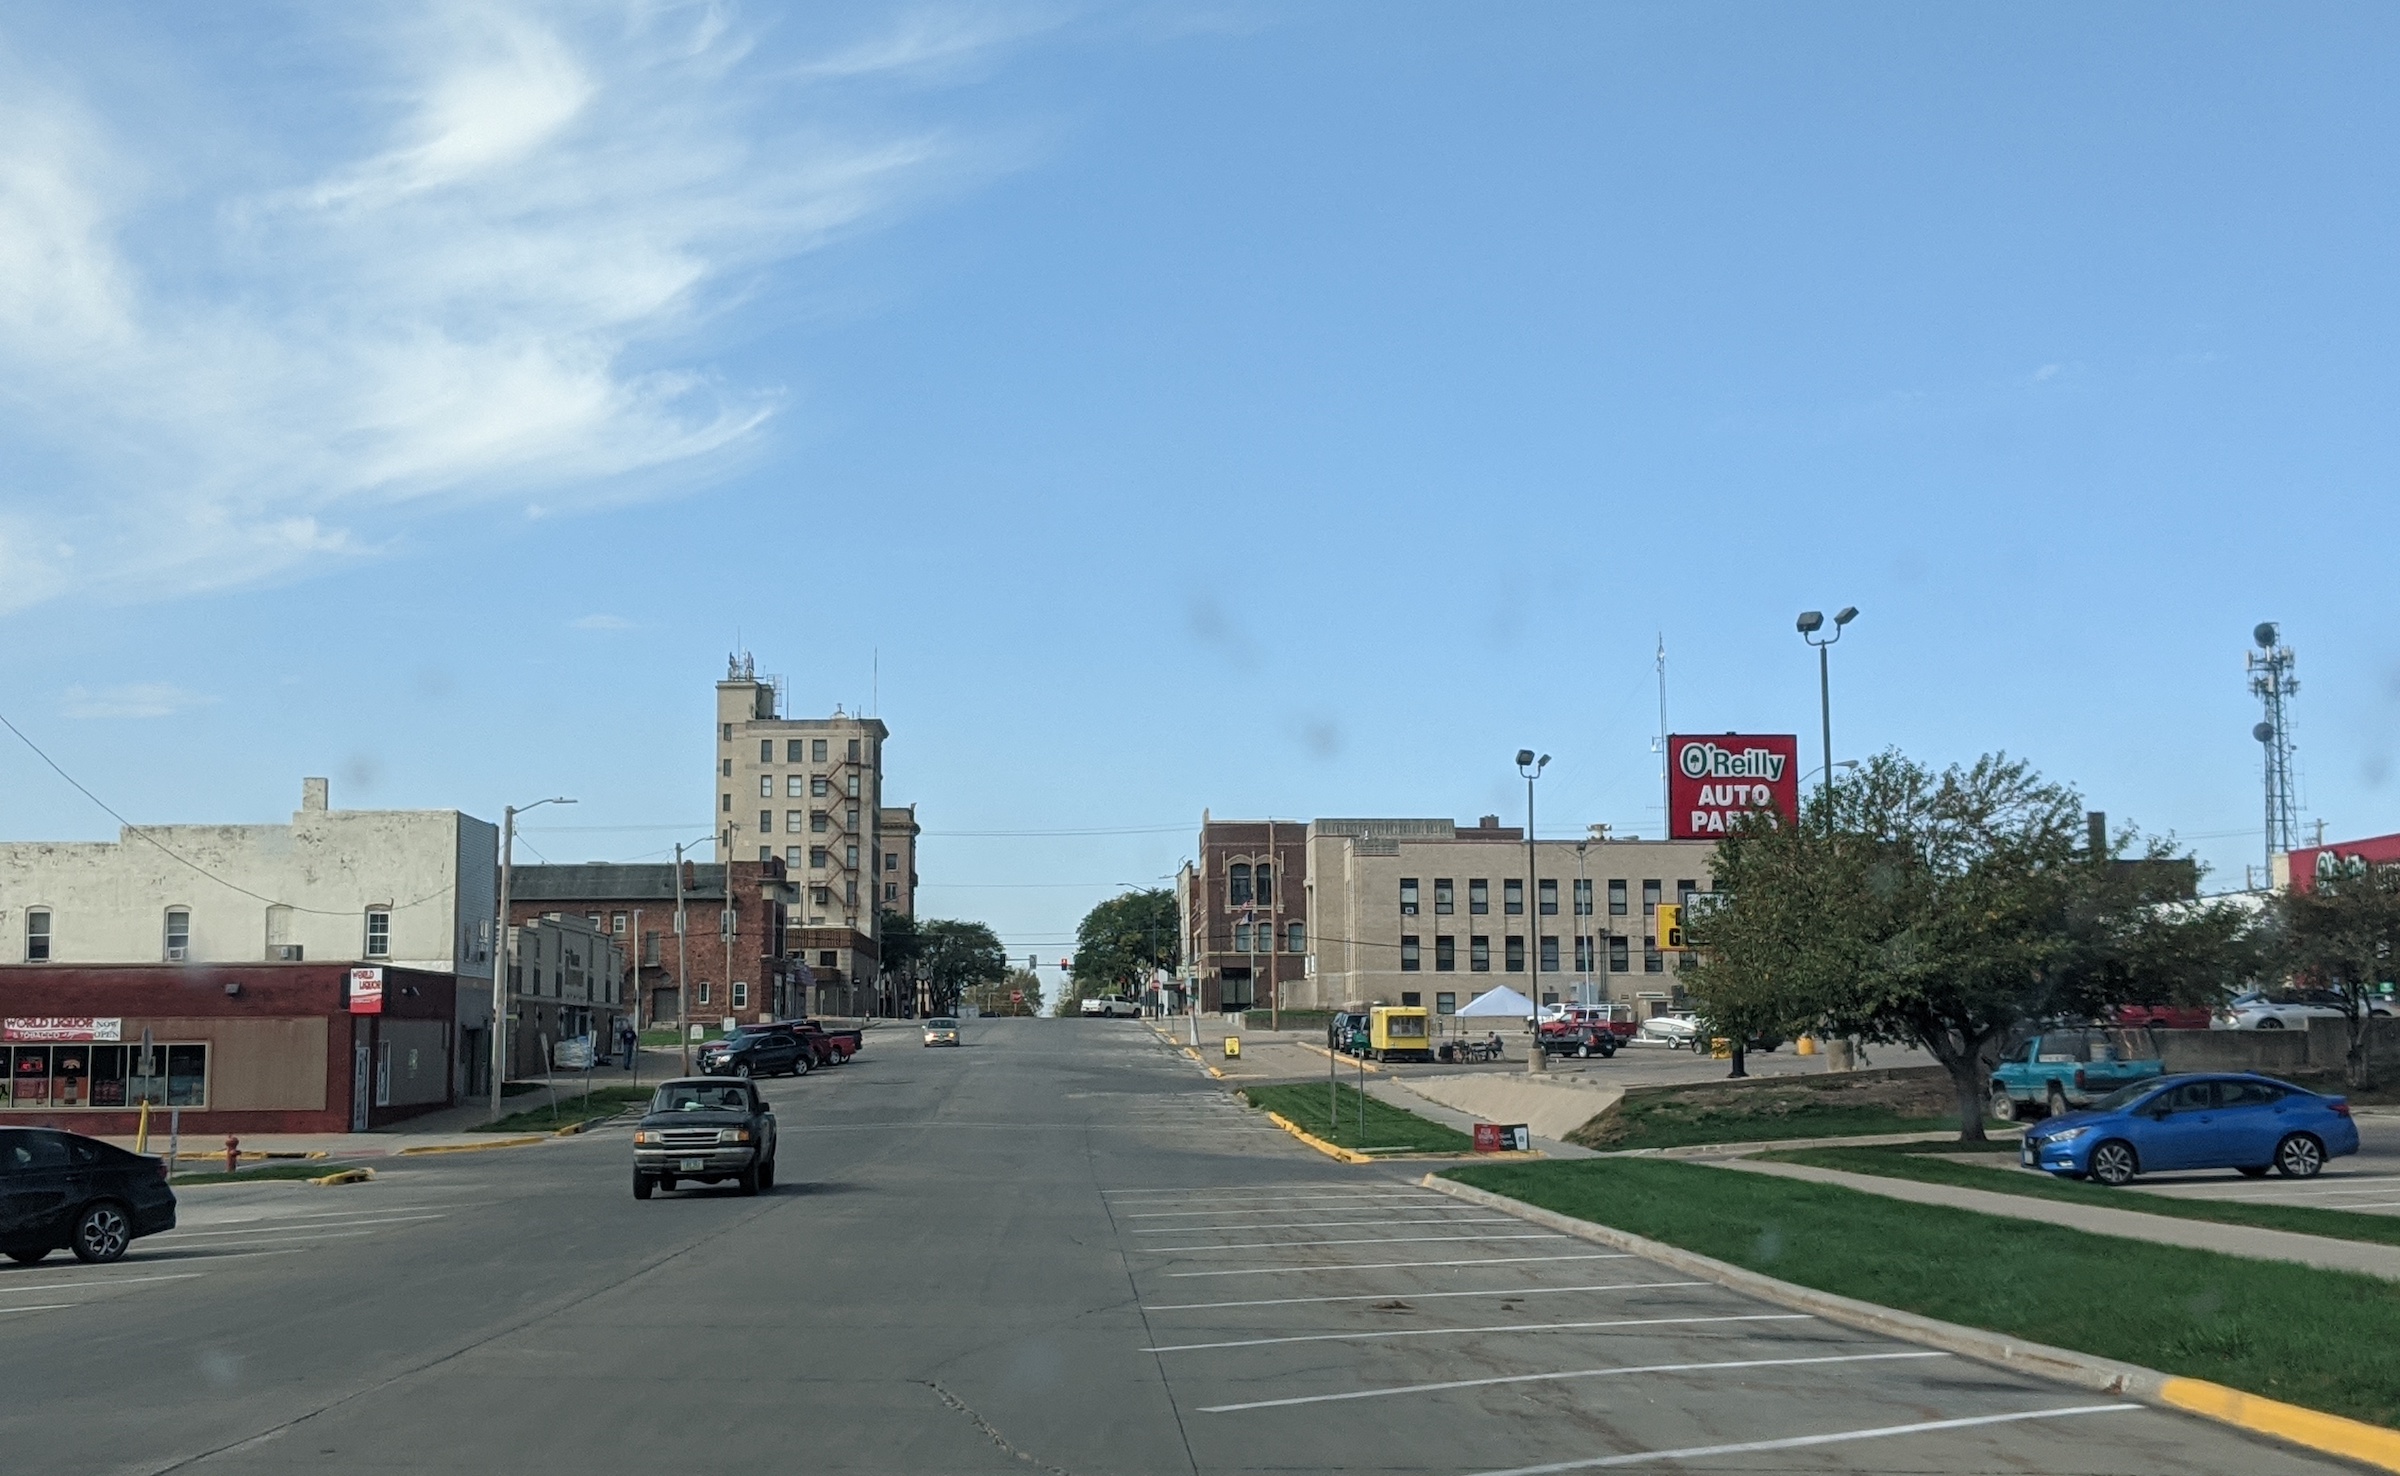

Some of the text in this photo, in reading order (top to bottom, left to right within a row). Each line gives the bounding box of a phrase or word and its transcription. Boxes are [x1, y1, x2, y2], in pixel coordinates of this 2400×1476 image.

[1680, 743, 1785, 781] O'Reilly
[1698, 784, 1771, 806] AUTO
[352, 970, 375, 980] WORLD
[359, 980, 382, 990] LIQUOR
[6, 1018, 93, 1028] WORLD LIQUOR
[20, 1030, 60, 1039] TOBACCO
